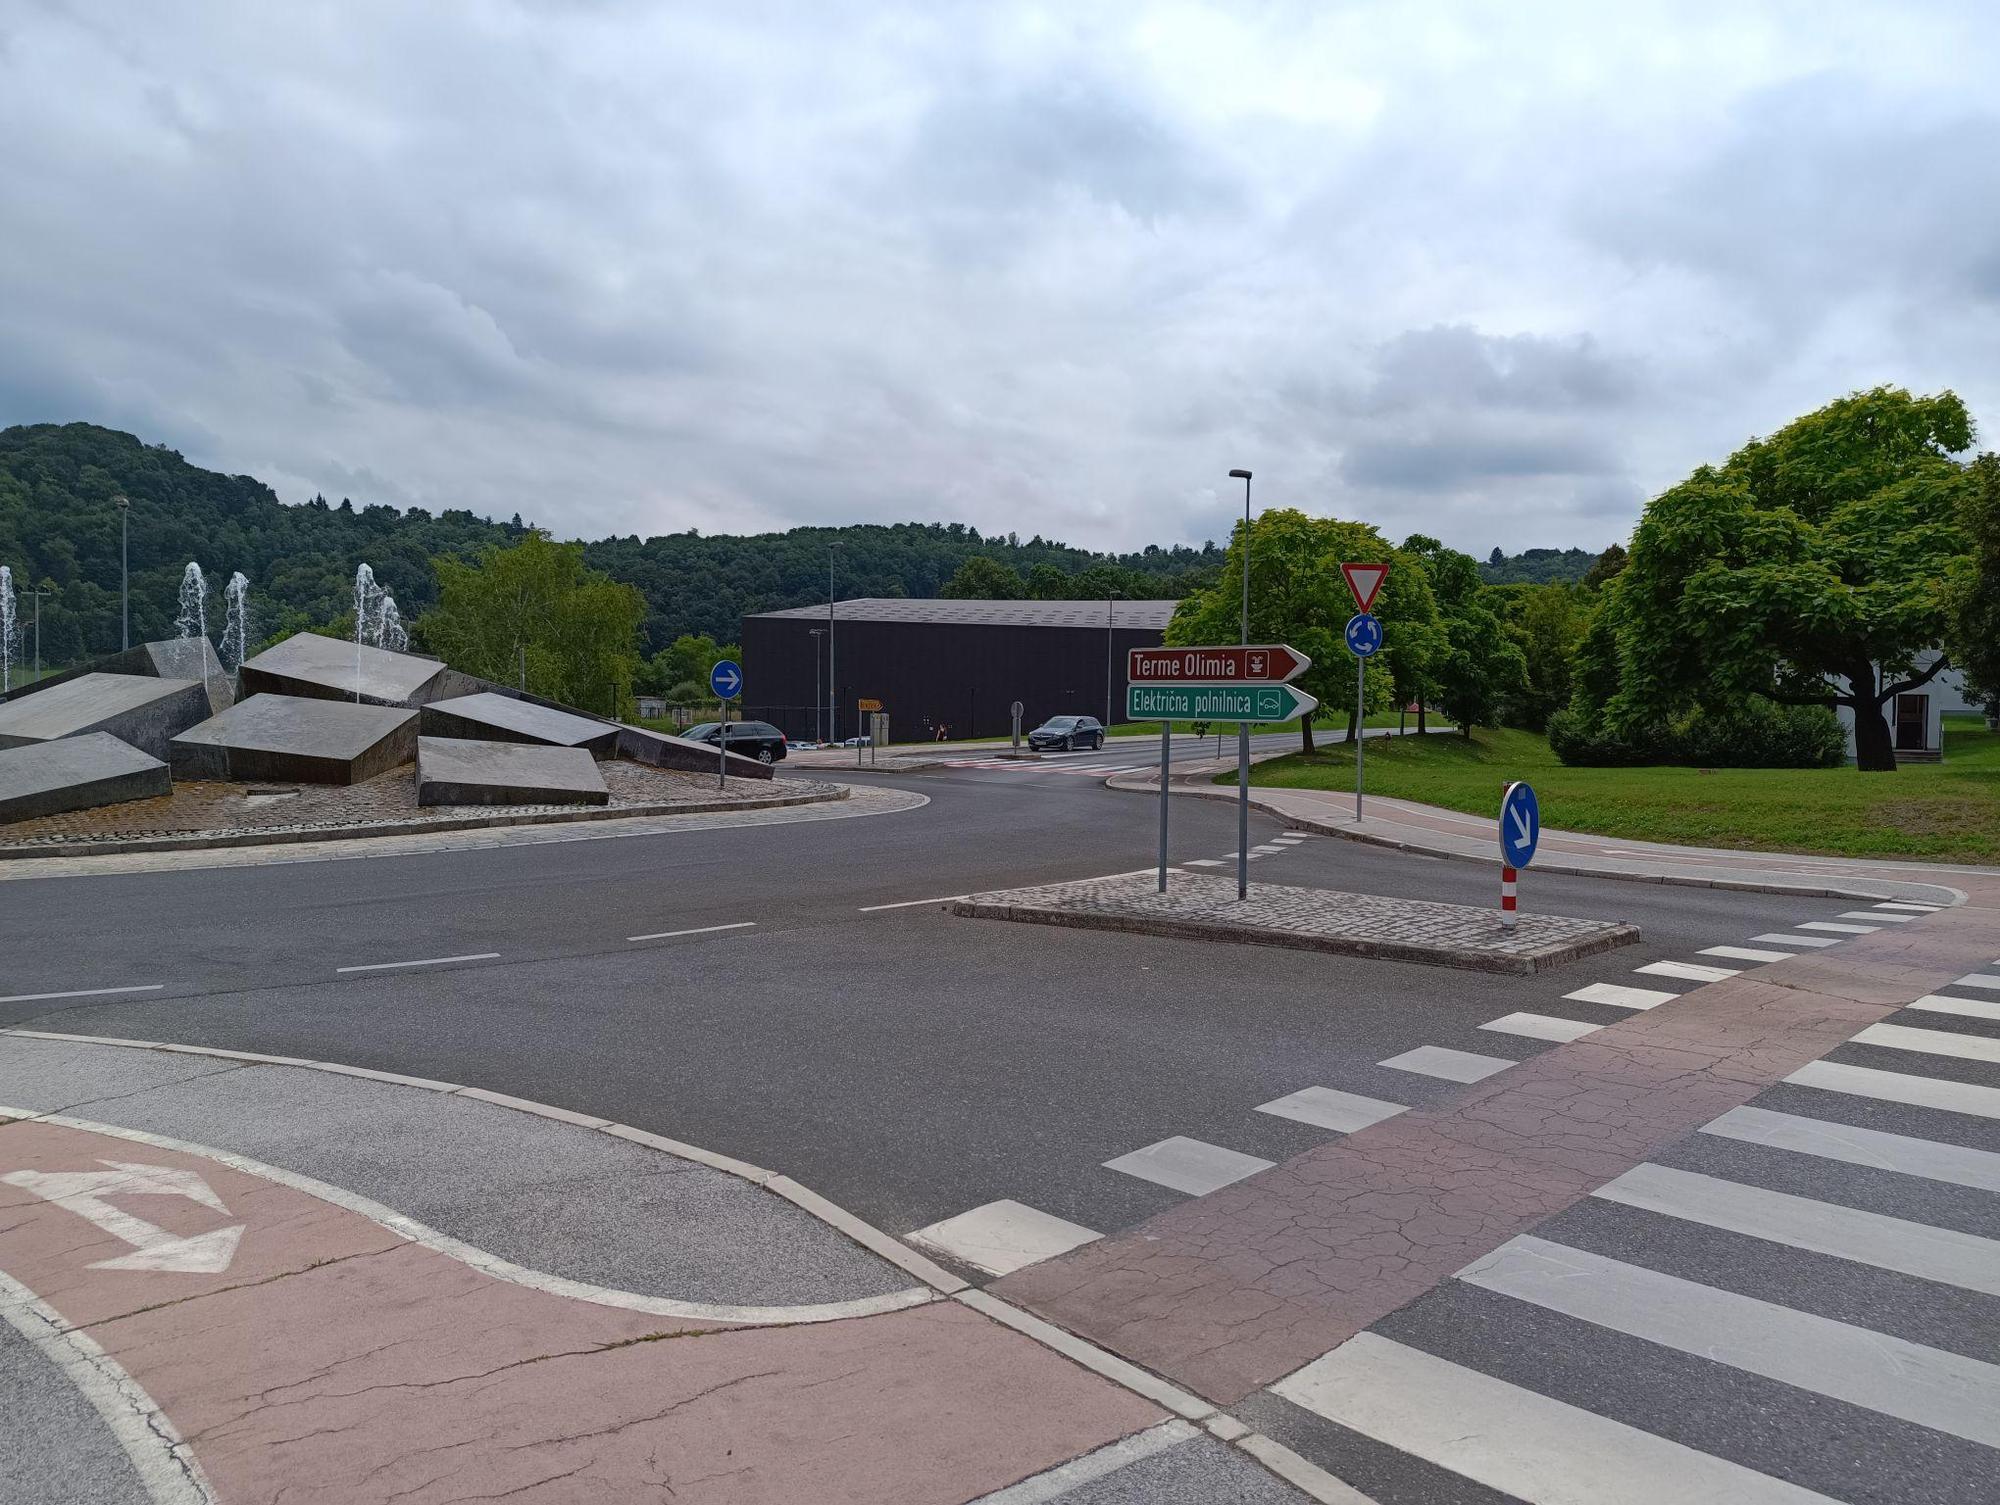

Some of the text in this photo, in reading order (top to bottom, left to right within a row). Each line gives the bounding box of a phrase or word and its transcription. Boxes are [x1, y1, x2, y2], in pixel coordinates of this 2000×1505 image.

[1135, 653, 1236, 676] Terme Olimia
[1133, 690, 1251, 718] Električna polnilnica
